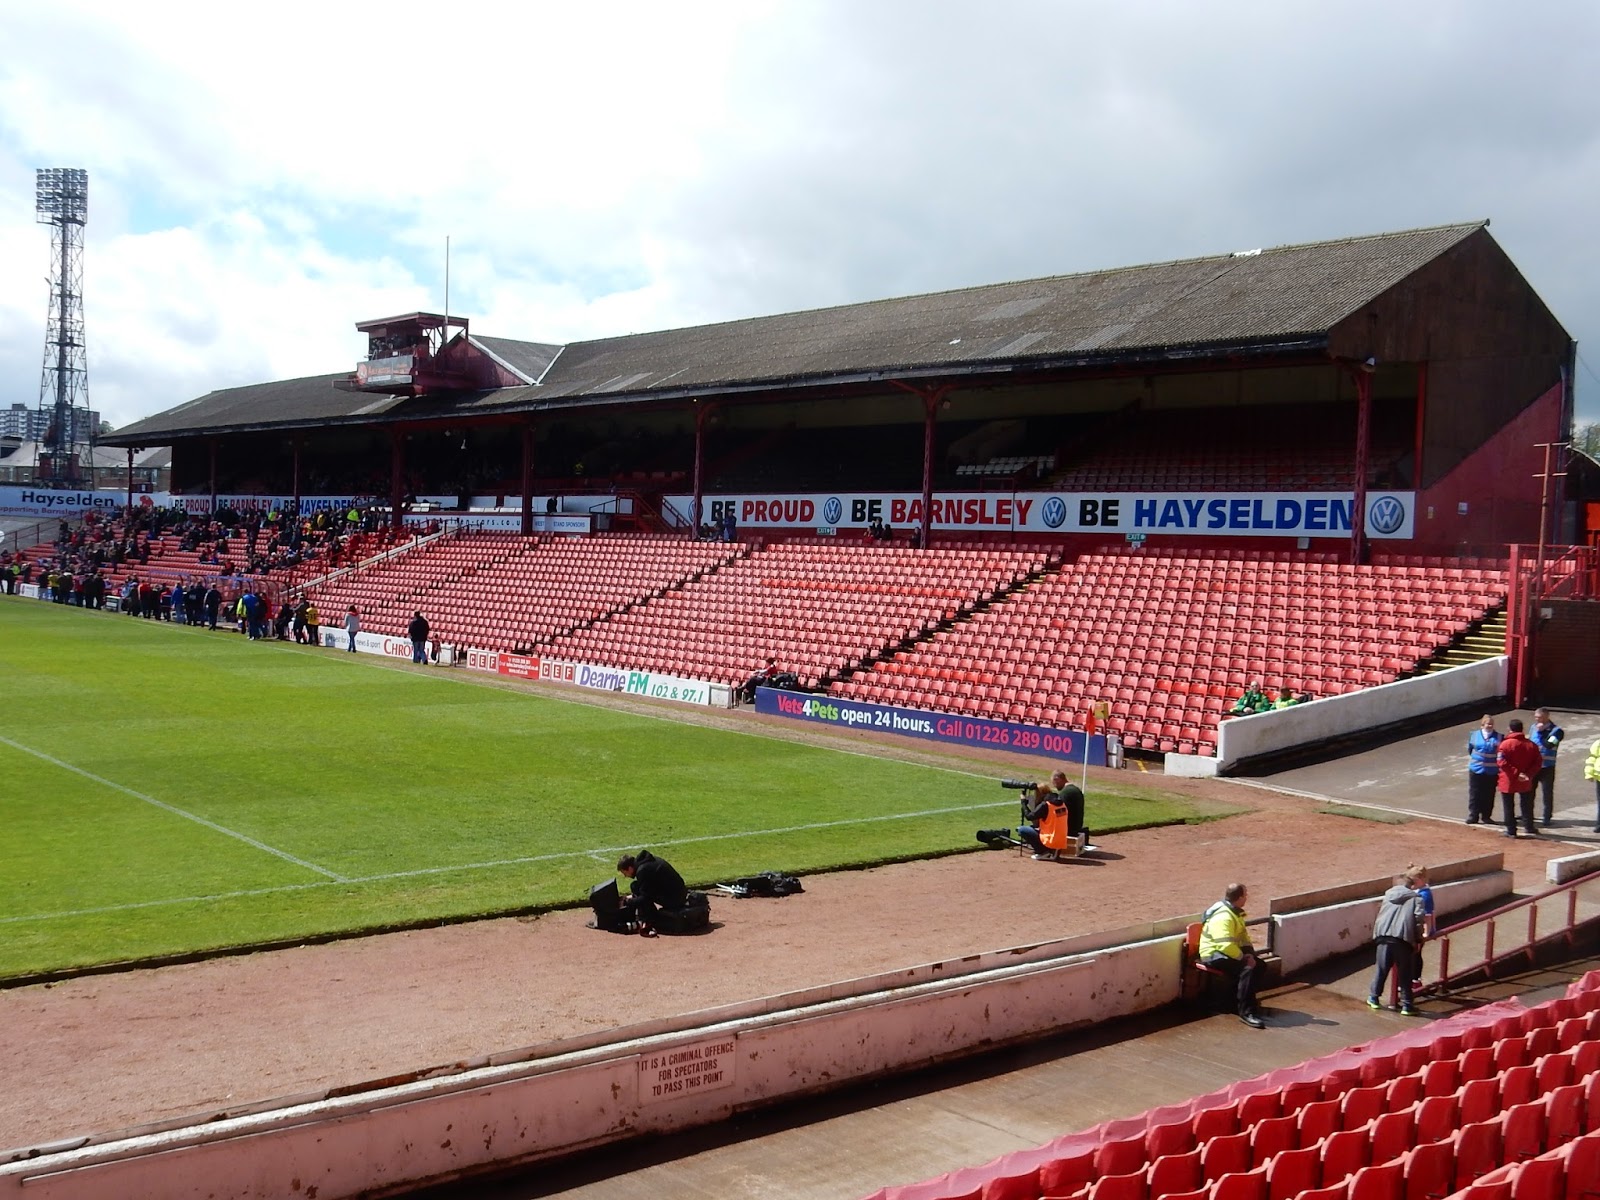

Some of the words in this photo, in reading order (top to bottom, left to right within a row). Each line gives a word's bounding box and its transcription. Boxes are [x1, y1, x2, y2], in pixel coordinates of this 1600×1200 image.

[22, 491, 114, 507] Hayselden
[185, 500, 210, 512] PROUD
[230, 500, 273, 512] BARNSLEY
[742, 500, 815, 522] PROUD
[851, 499, 882, 522] BE
[891, 499, 1033, 525] BARNSLEY
[1079, 499, 1119, 526] BE
[1134, 499, 1355, 530] HAYSELDEN
[580, 666, 626, 690] Dearne
[627, 672, 649, 694] FM
[651, 684, 668, 698] 102
[670, 687, 678, 699] &
[682, 688, 703, 703] 97.1
[777, 695, 838, 720] Vets4Pets
[841, 708, 872, 725] open
[874, 710, 890, 727] 24
[893, 712, 934, 733] hours.
[937, 719, 962, 737] Call
[965, 723, 1009, 744] 01226
[1012, 730, 1040, 748] 289
[1043, 734, 1073, 754] 000
[641, 1060, 648, 1071] IT
[651, 1058, 658, 1069] IS
[661, 1057, 666, 1067] A
[669, 1048, 702, 1066] CRIMINAL
[705, 1041, 734, 1058] OFFENCE
[659, 1069, 672, 1082] FOR
[674, 1058, 718, 1078] SPECTATORS
[653, 1085, 661, 1096] TO
[664, 1080, 683, 1094] PASS
[686, 1076, 701, 1089] THIS
[703, 1070, 723, 1085] POINT
